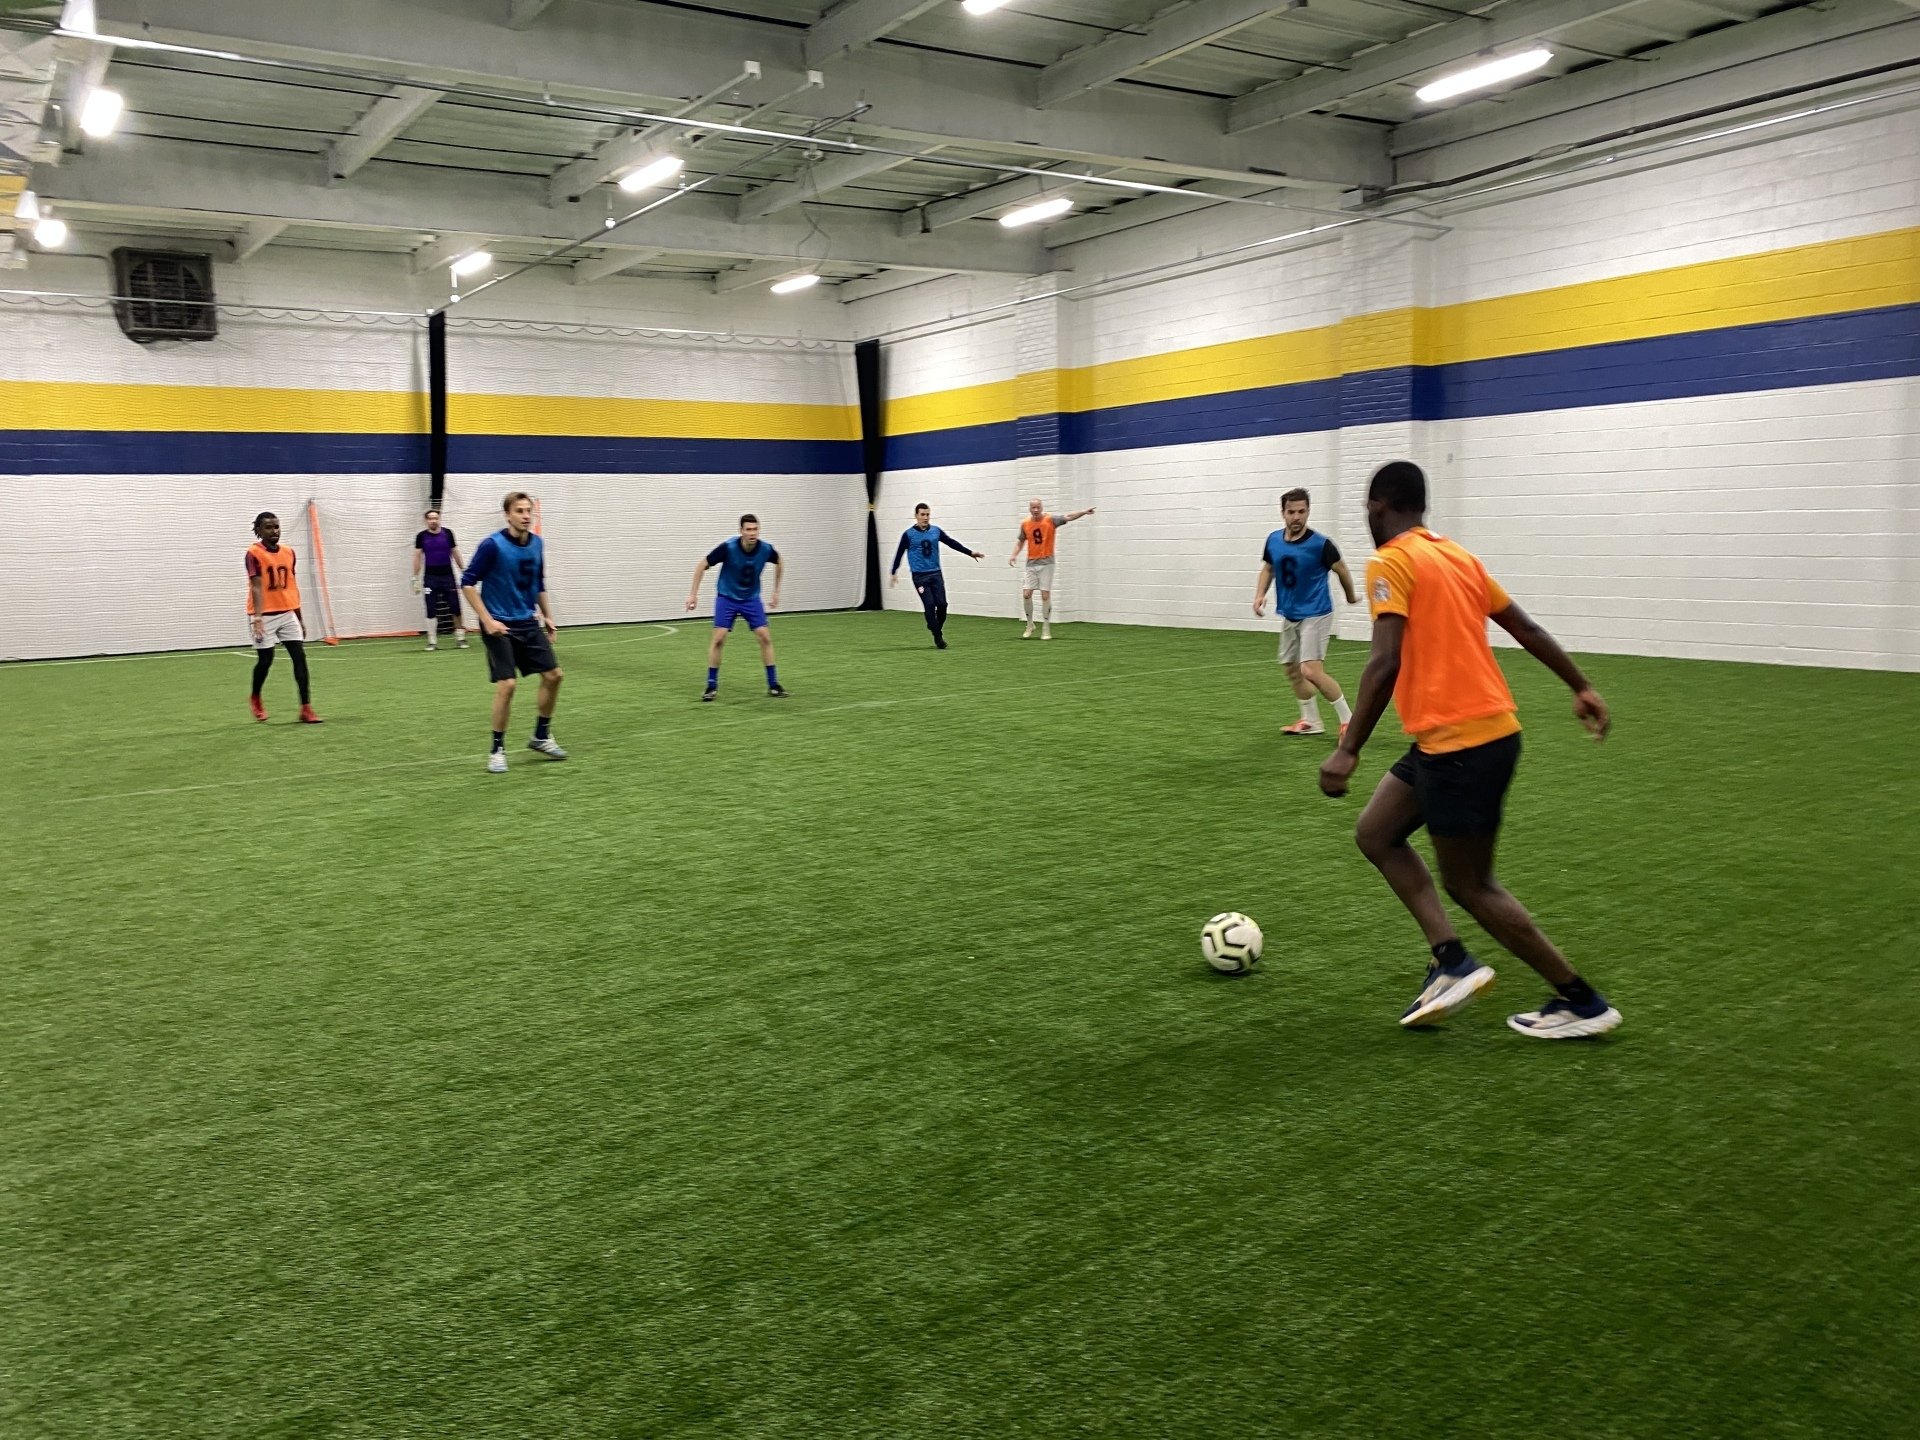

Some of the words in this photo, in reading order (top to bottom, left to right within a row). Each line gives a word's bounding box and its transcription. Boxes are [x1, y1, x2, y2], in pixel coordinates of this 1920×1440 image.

[267, 565, 288, 590] 10
[517, 559, 535, 590] 5
[1281, 556, 1297, 588] 6
